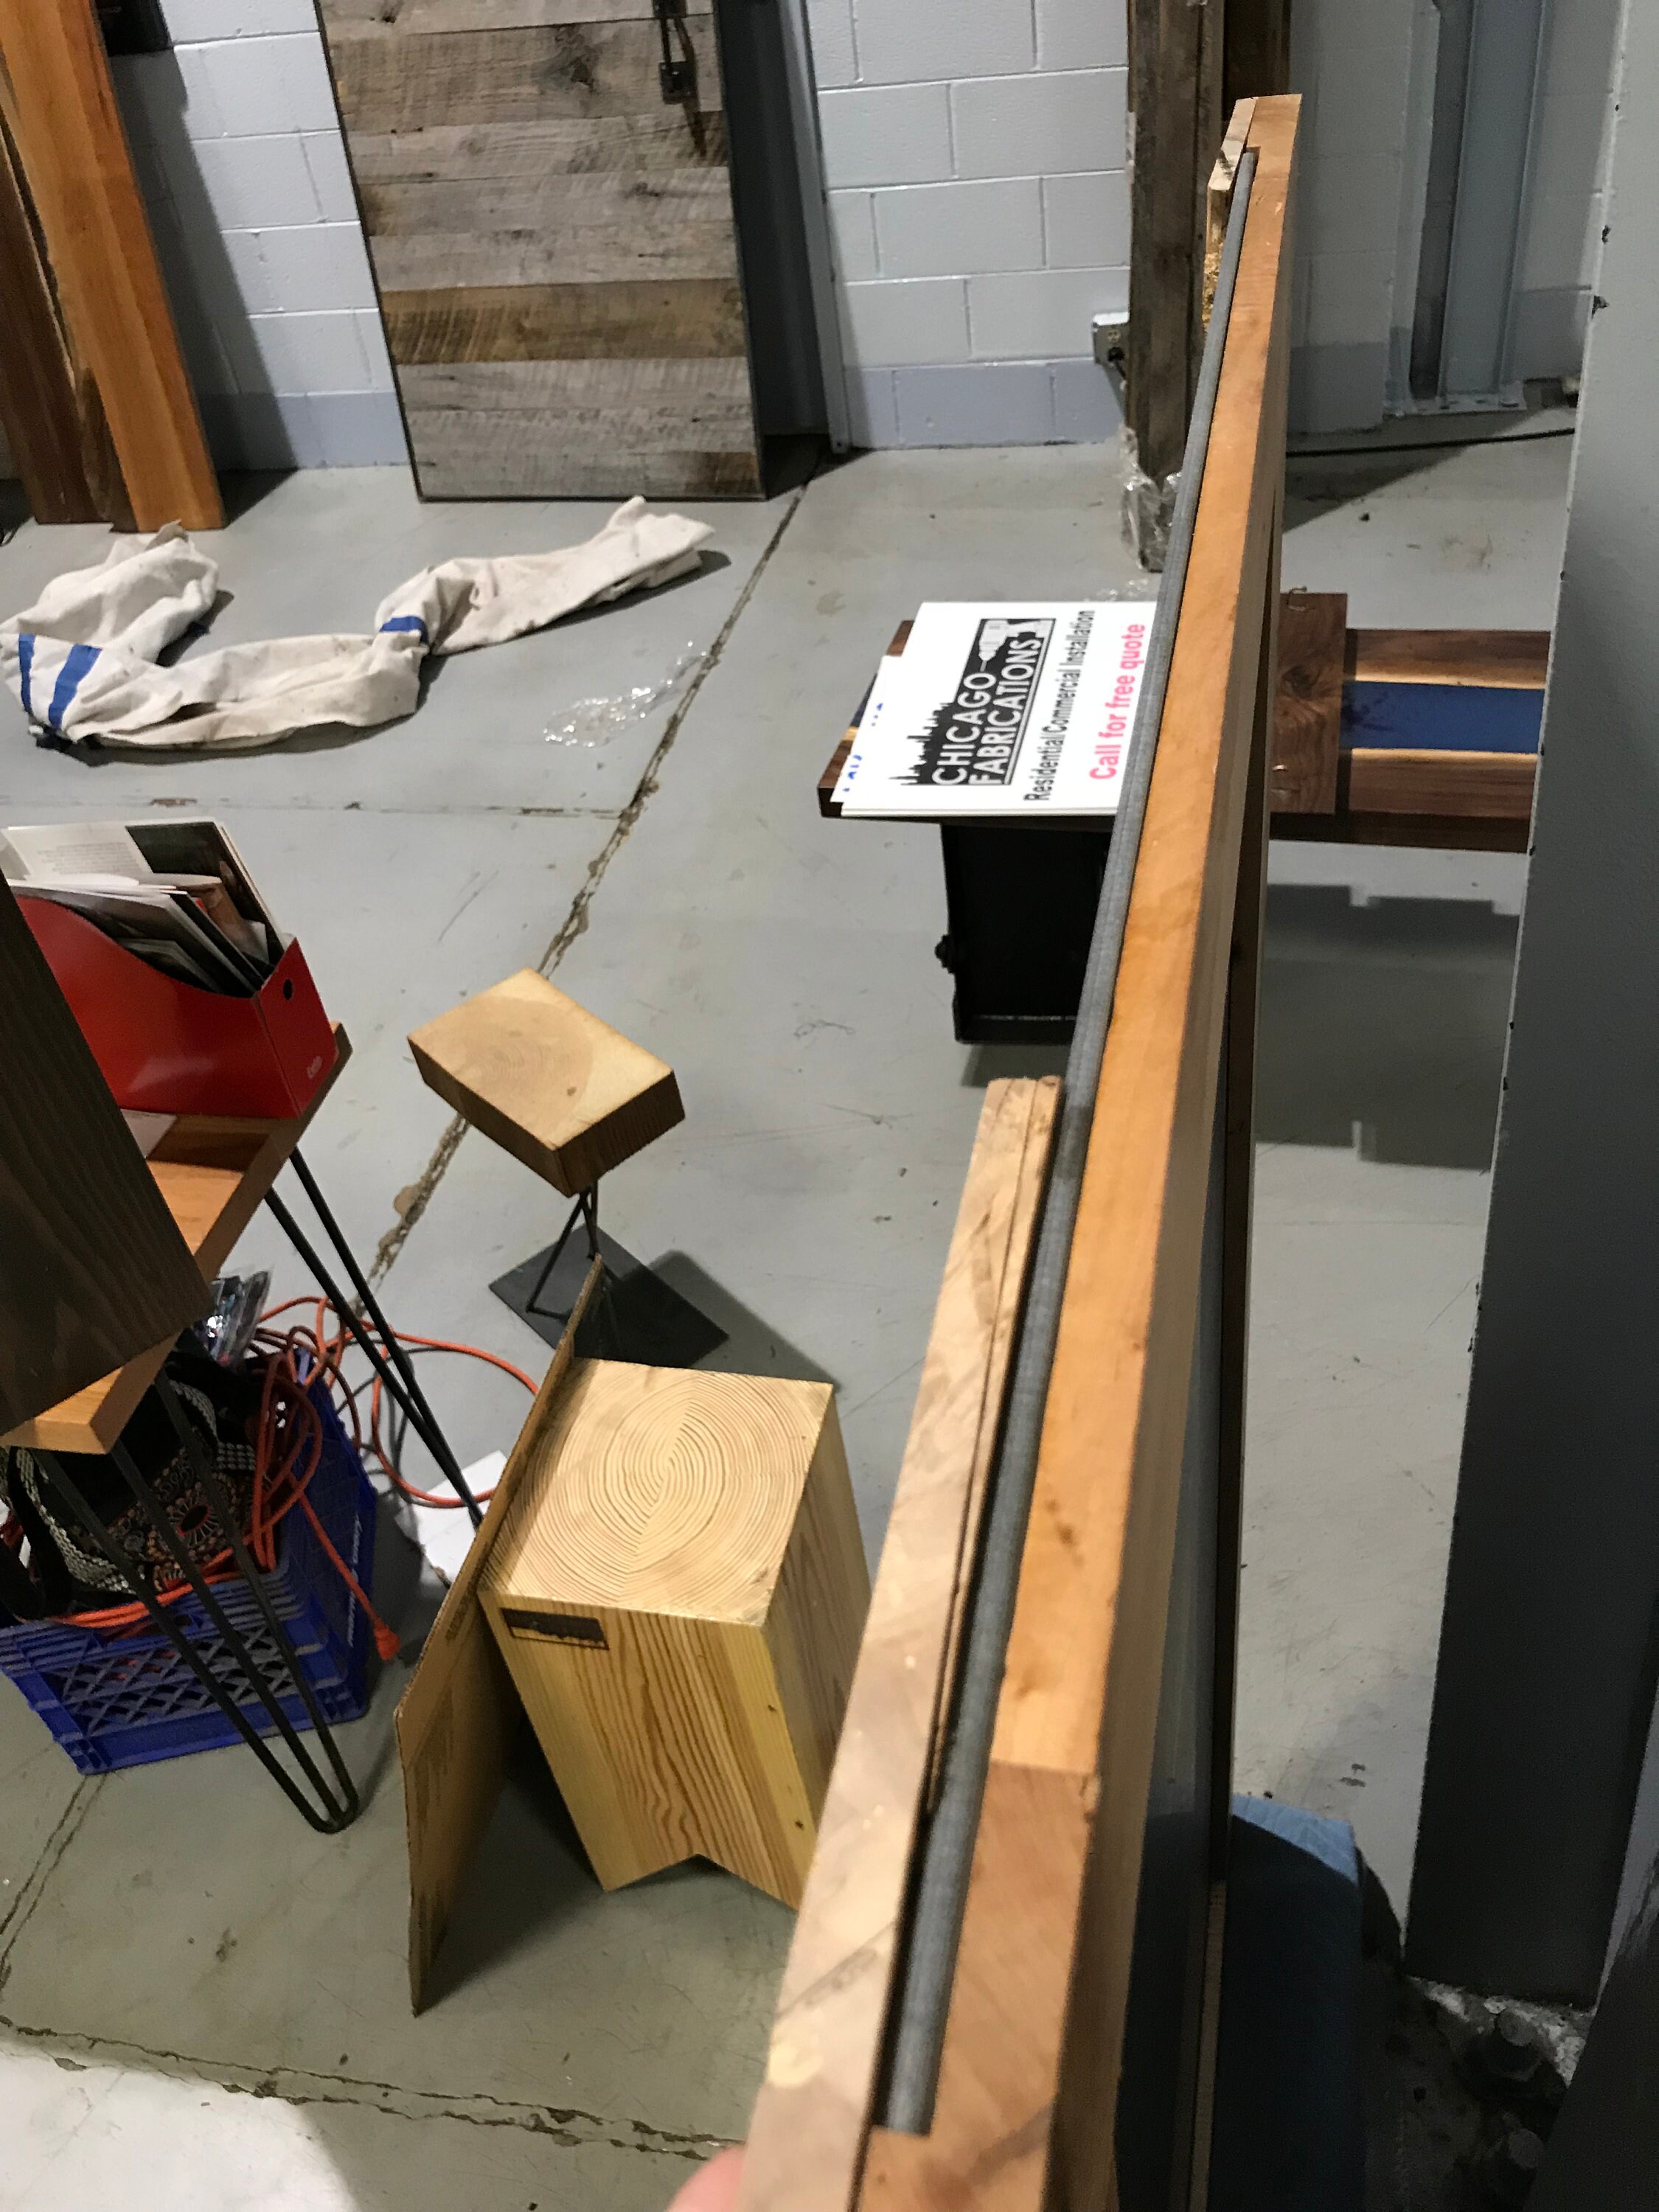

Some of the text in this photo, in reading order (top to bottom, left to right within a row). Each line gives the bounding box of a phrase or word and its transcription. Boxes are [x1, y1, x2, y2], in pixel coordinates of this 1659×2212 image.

[1060, 611, 1095, 665] Installation
[1089, 624, 1145, 779] Call for free quote
[932, 672, 996, 785] CHICAGO
[968, 639, 1042, 785] FABRICATIONS
